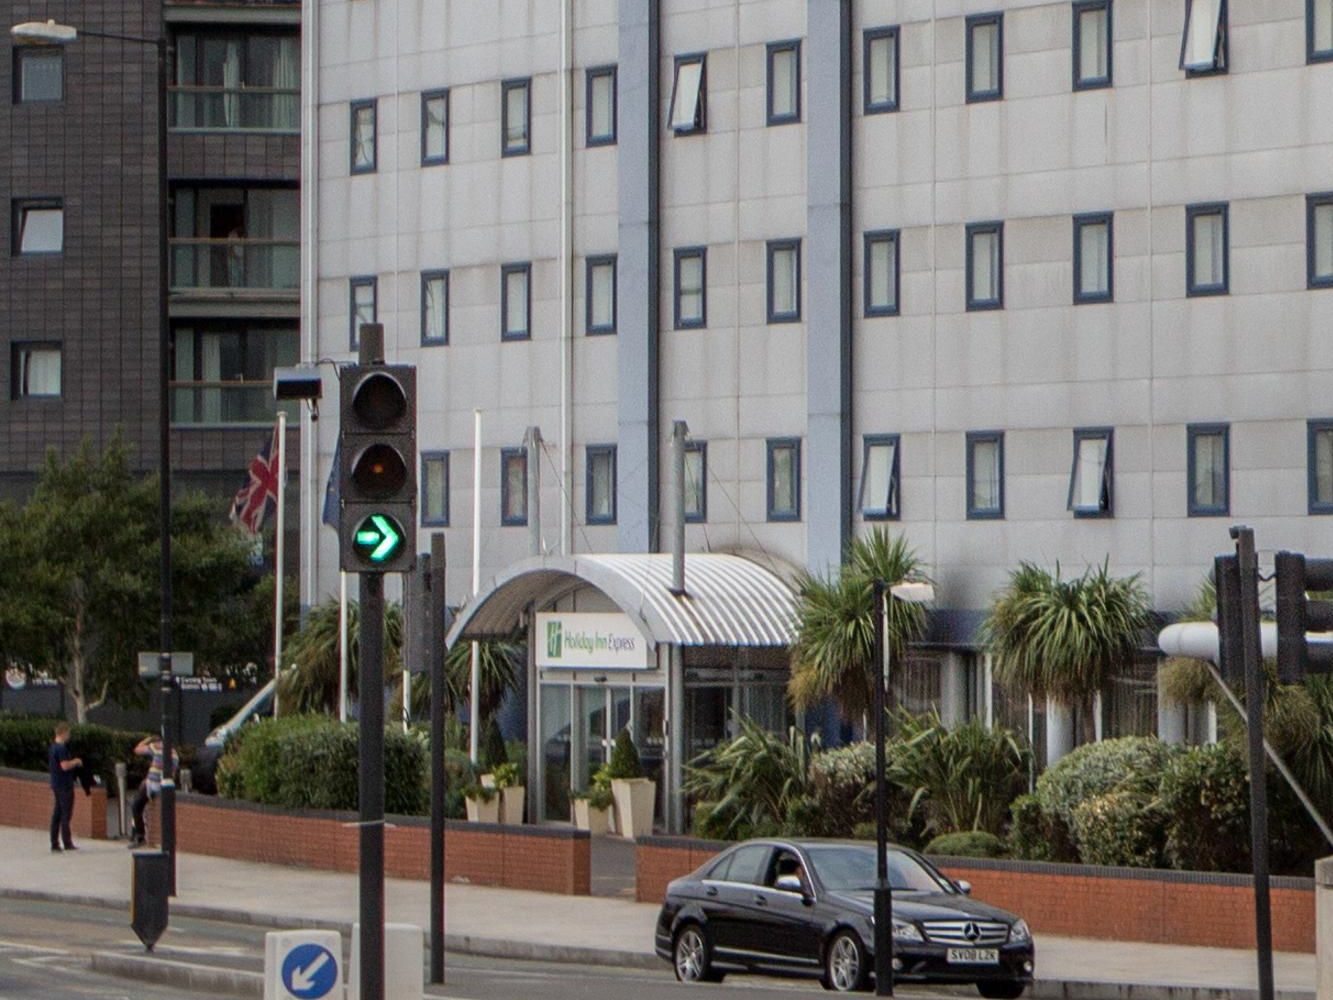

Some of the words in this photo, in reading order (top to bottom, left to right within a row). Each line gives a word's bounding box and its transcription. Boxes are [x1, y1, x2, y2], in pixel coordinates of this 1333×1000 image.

[564, 630, 594, 654] Holiday
[595, 631, 608, 650] Inn
[608, 633, 635, 652] Express
